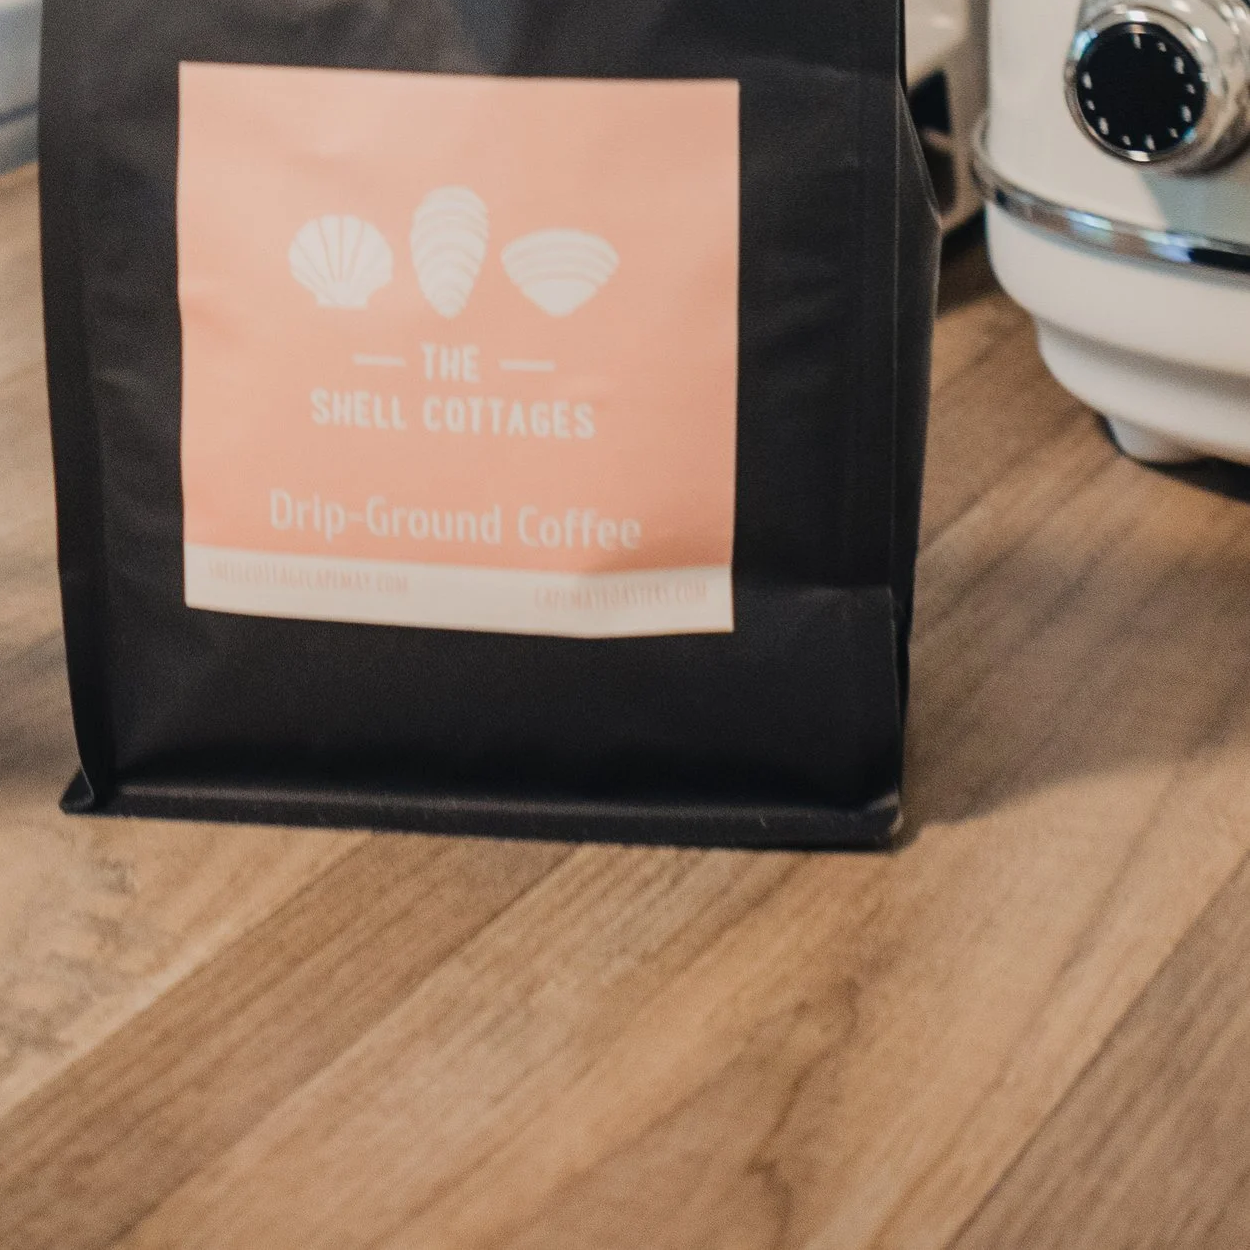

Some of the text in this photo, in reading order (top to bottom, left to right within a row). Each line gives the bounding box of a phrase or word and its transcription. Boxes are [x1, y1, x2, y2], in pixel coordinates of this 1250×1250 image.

[422, 342, 481, 382] THE
[310, 388, 596, 440] SHELL COTTAGES
[269, 488, 643, 550] Drip-Ground Coffee
